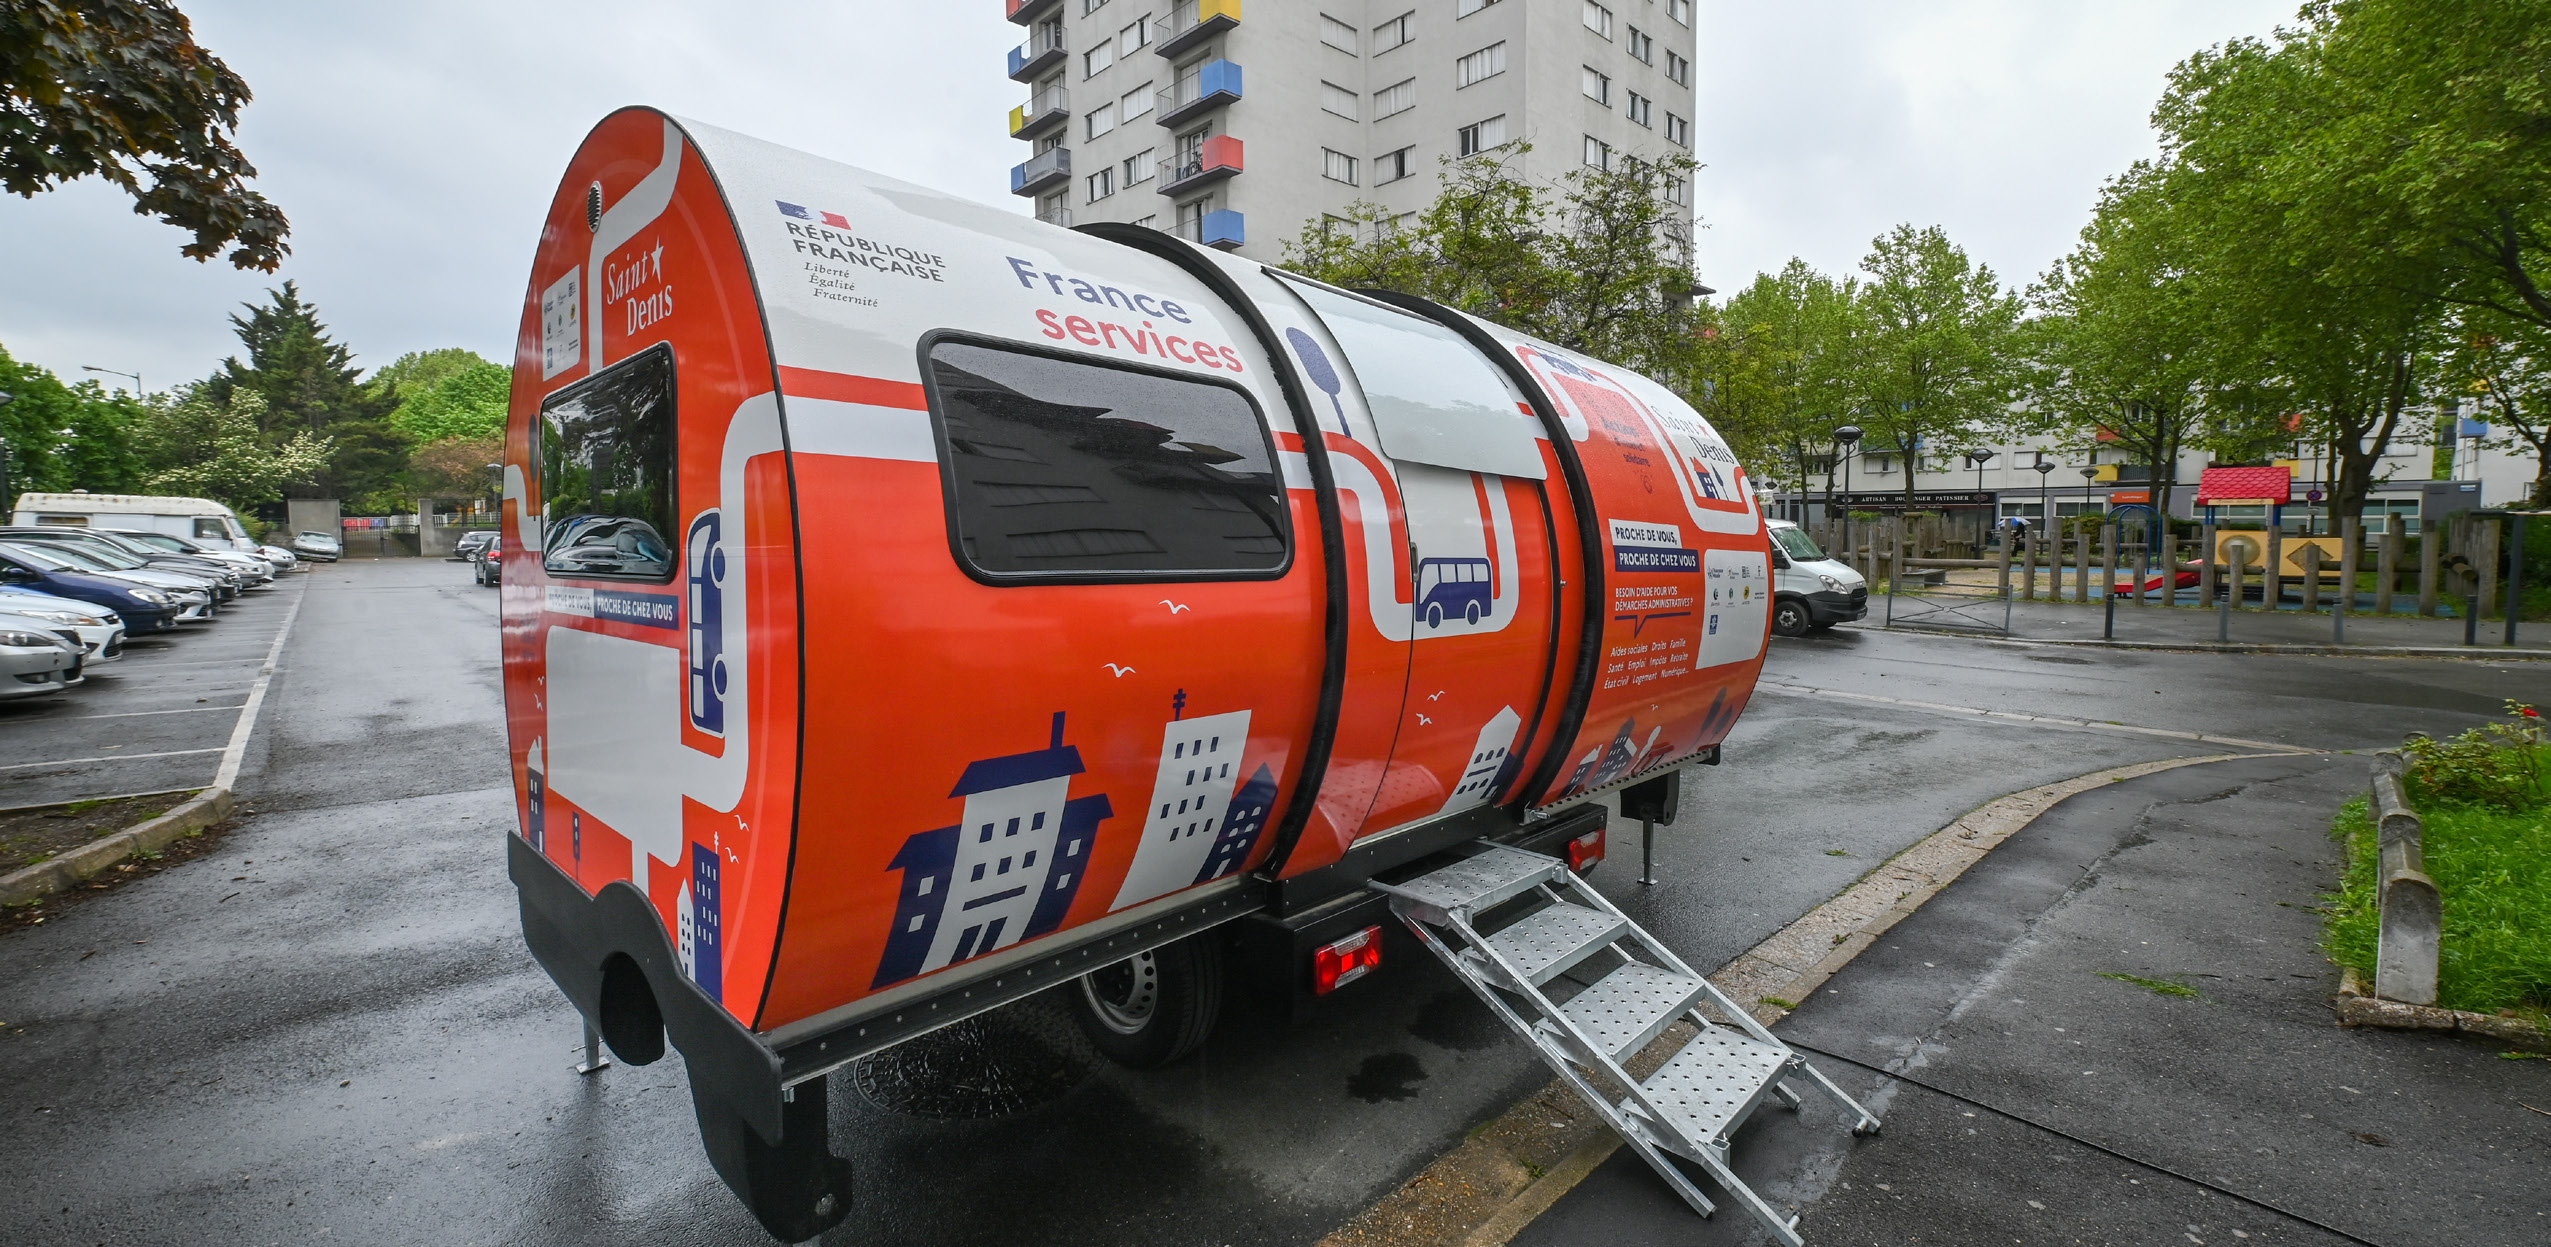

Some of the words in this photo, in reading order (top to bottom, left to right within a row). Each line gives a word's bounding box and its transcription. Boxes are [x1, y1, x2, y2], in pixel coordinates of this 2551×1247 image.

[785, 221, 946, 268] RÉPUBLIQUE
[793, 239, 944, 282] FRANÇAISE
[804, 262, 850, 278] Liberté
[607, 250, 648, 305] Saint
[808, 273, 855, 291] Égalité
[813, 288, 878, 307] Fraternité
[1006, 256, 1192, 324] France
[627, 285, 673, 336] Denis
[1035, 309, 1243, 373] services
[1651, 405, 1699, 435] Saint
[1689, 435, 1734, 464] Denis
[1615, 527, 1645, 541] PROCHE
[1647, 530, 1656, 541] DE
[1656, 531, 1677, 545] VOUS,
[1619, 553, 1649, 566] PROCHE
[1650, 554, 1659, 566] DE
[1661, 554, 1678, 567] CHEZ
[1679, 554, 1696, 567] VOUS
[1616, 588, 1635, 597] BESOIN
[1637, 587, 1653, 597] D'AIDE
[1654, 586, 1667, 596] POUR
[1668, 586, 1677, 595] VOS
[597, 597, 620, 614] PROCHE
[622, 599, 631, 616] DE
[632, 600, 651, 618] CHEZ
[652, 602, 673, 621] VOUS
[1615, 599, 1648, 611] DÉMARCHES
[1648, 598, 1690, 609] ADMINISTRATIVES
[1610, 646, 1627, 657] Aides
[1628, 644, 1648, 655] sociales
[1652, 641, 1667, 651] Droits
[1670, 638, 1686, 648] Famille
[1608, 661, 1624, 673] Santé
[1628, 658, 1646, 671] Emploi
[1650, 655, 1667, 667] Impôts
[1670, 652, 1688, 663] Retraite
[1604, 677, 1616, 689] État
[1617, 675, 1629, 687] civil
[1633, 672, 1657, 685] Logement
